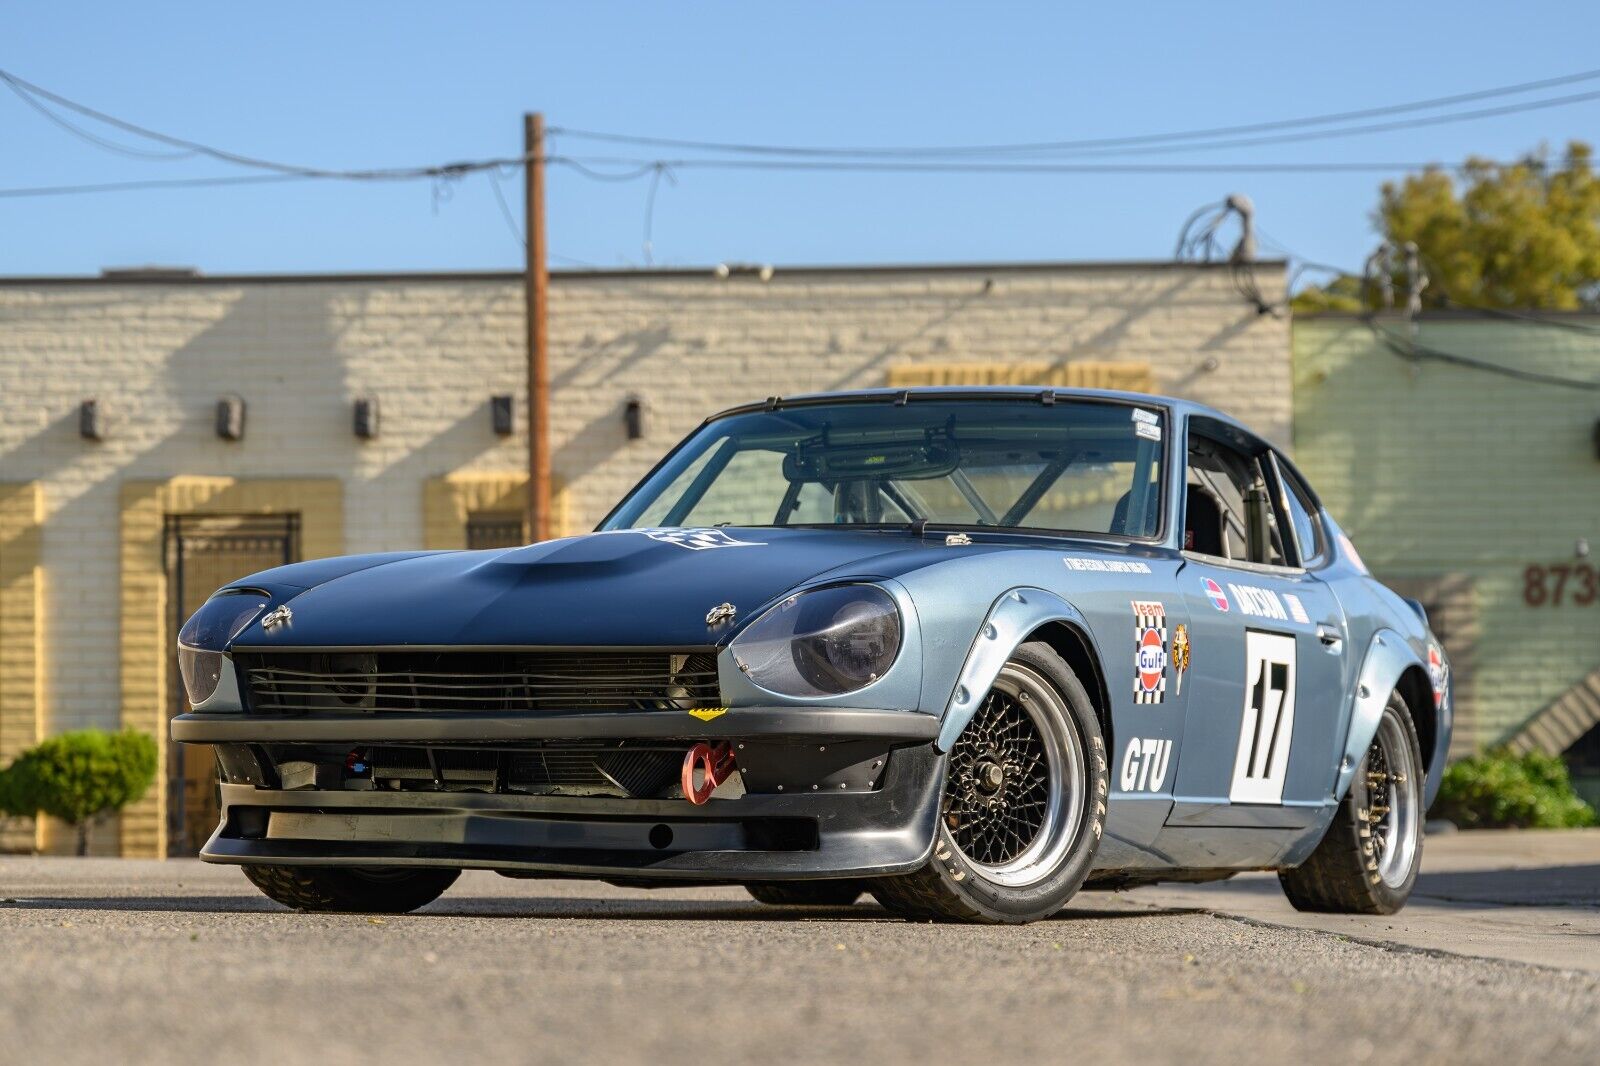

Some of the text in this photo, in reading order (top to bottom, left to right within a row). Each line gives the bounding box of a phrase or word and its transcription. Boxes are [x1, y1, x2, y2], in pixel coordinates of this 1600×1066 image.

[1227, 583, 1288, 620] DATSUN
[1523, 565, 1600, 607] 873
[1133, 601, 1165, 616] team
[1140, 650, 1163, 669] Gulf
[1246, 659, 1289, 778] 17
[1120, 737, 1172, 792] GTU
